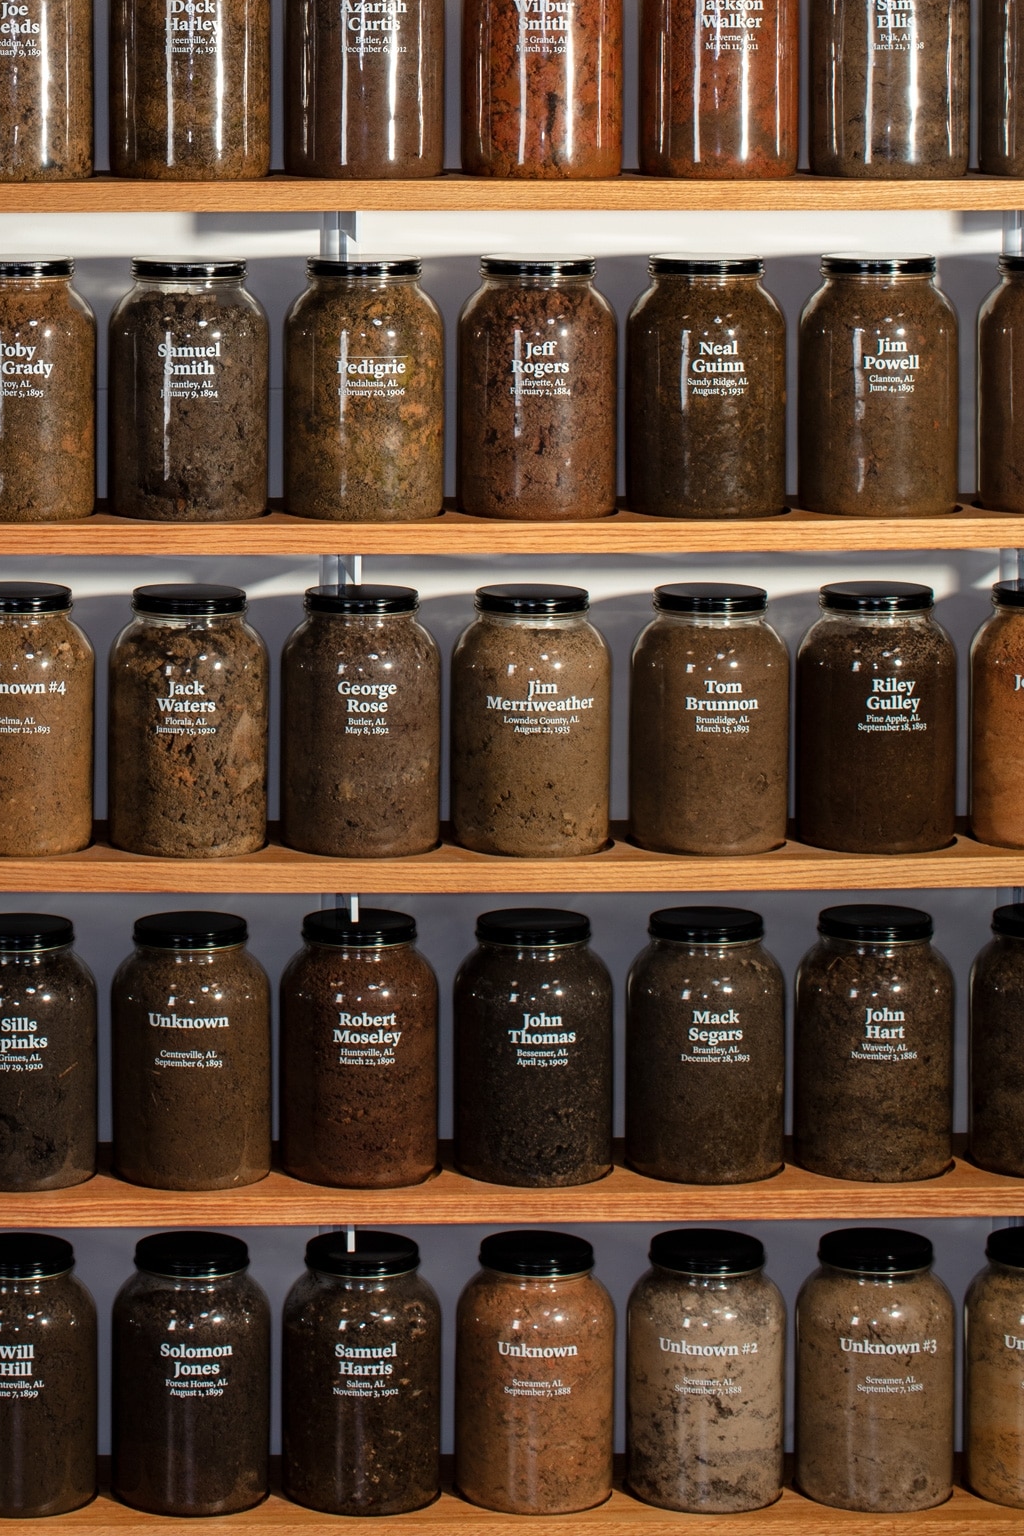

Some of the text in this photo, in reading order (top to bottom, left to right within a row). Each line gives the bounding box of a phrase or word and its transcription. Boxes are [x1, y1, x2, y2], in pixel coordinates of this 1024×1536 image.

[1, 2, 28, 20] Joe
[702, 14, 762, 28] Walker
[699, 340, 738, 355] Neal
[877, 337, 907, 355] Jim
[692, 358, 745, 373] Guinn
[863, 355, 920, 370] Powell
[687, 377, 749, 388] Sandy Ridge, AL
[869, 374, 903, 384] Clanton,
[692, 387, 744, 396] August 5, 1931
[869, 383, 888, 392] June
[898, 384, 914, 392] 1895
[48, 681, 66, 695] #4
[704, 680, 742, 694] Tom
[685, 697, 758, 711] Brunnon
[696, 715, 750, 726] Brundidge, AL
[34, 725, 50, 734] 1893
[696, 724, 750, 734] March 15, 1893
[693, 1009, 740, 1024] Mack
[1, 1017, 37, 1032] Sills
[689, 1027, 743, 1046] Segars
[29, 1053, 41, 1061] AL
[12, 1064, 24, 1072] 29,
[25, 1063, 43, 1072] 1920
[840, 1337, 937, 1355] Unknown #3
[0, 1362, 32, 1376] Hill
[33, 1380, 44, 1388] AL
[865, 1376, 916, 1385] Screamer, AL
[20, 1389, 38, 1398] 1899
[857, 1383, 923, 1394] September 7, 1888
